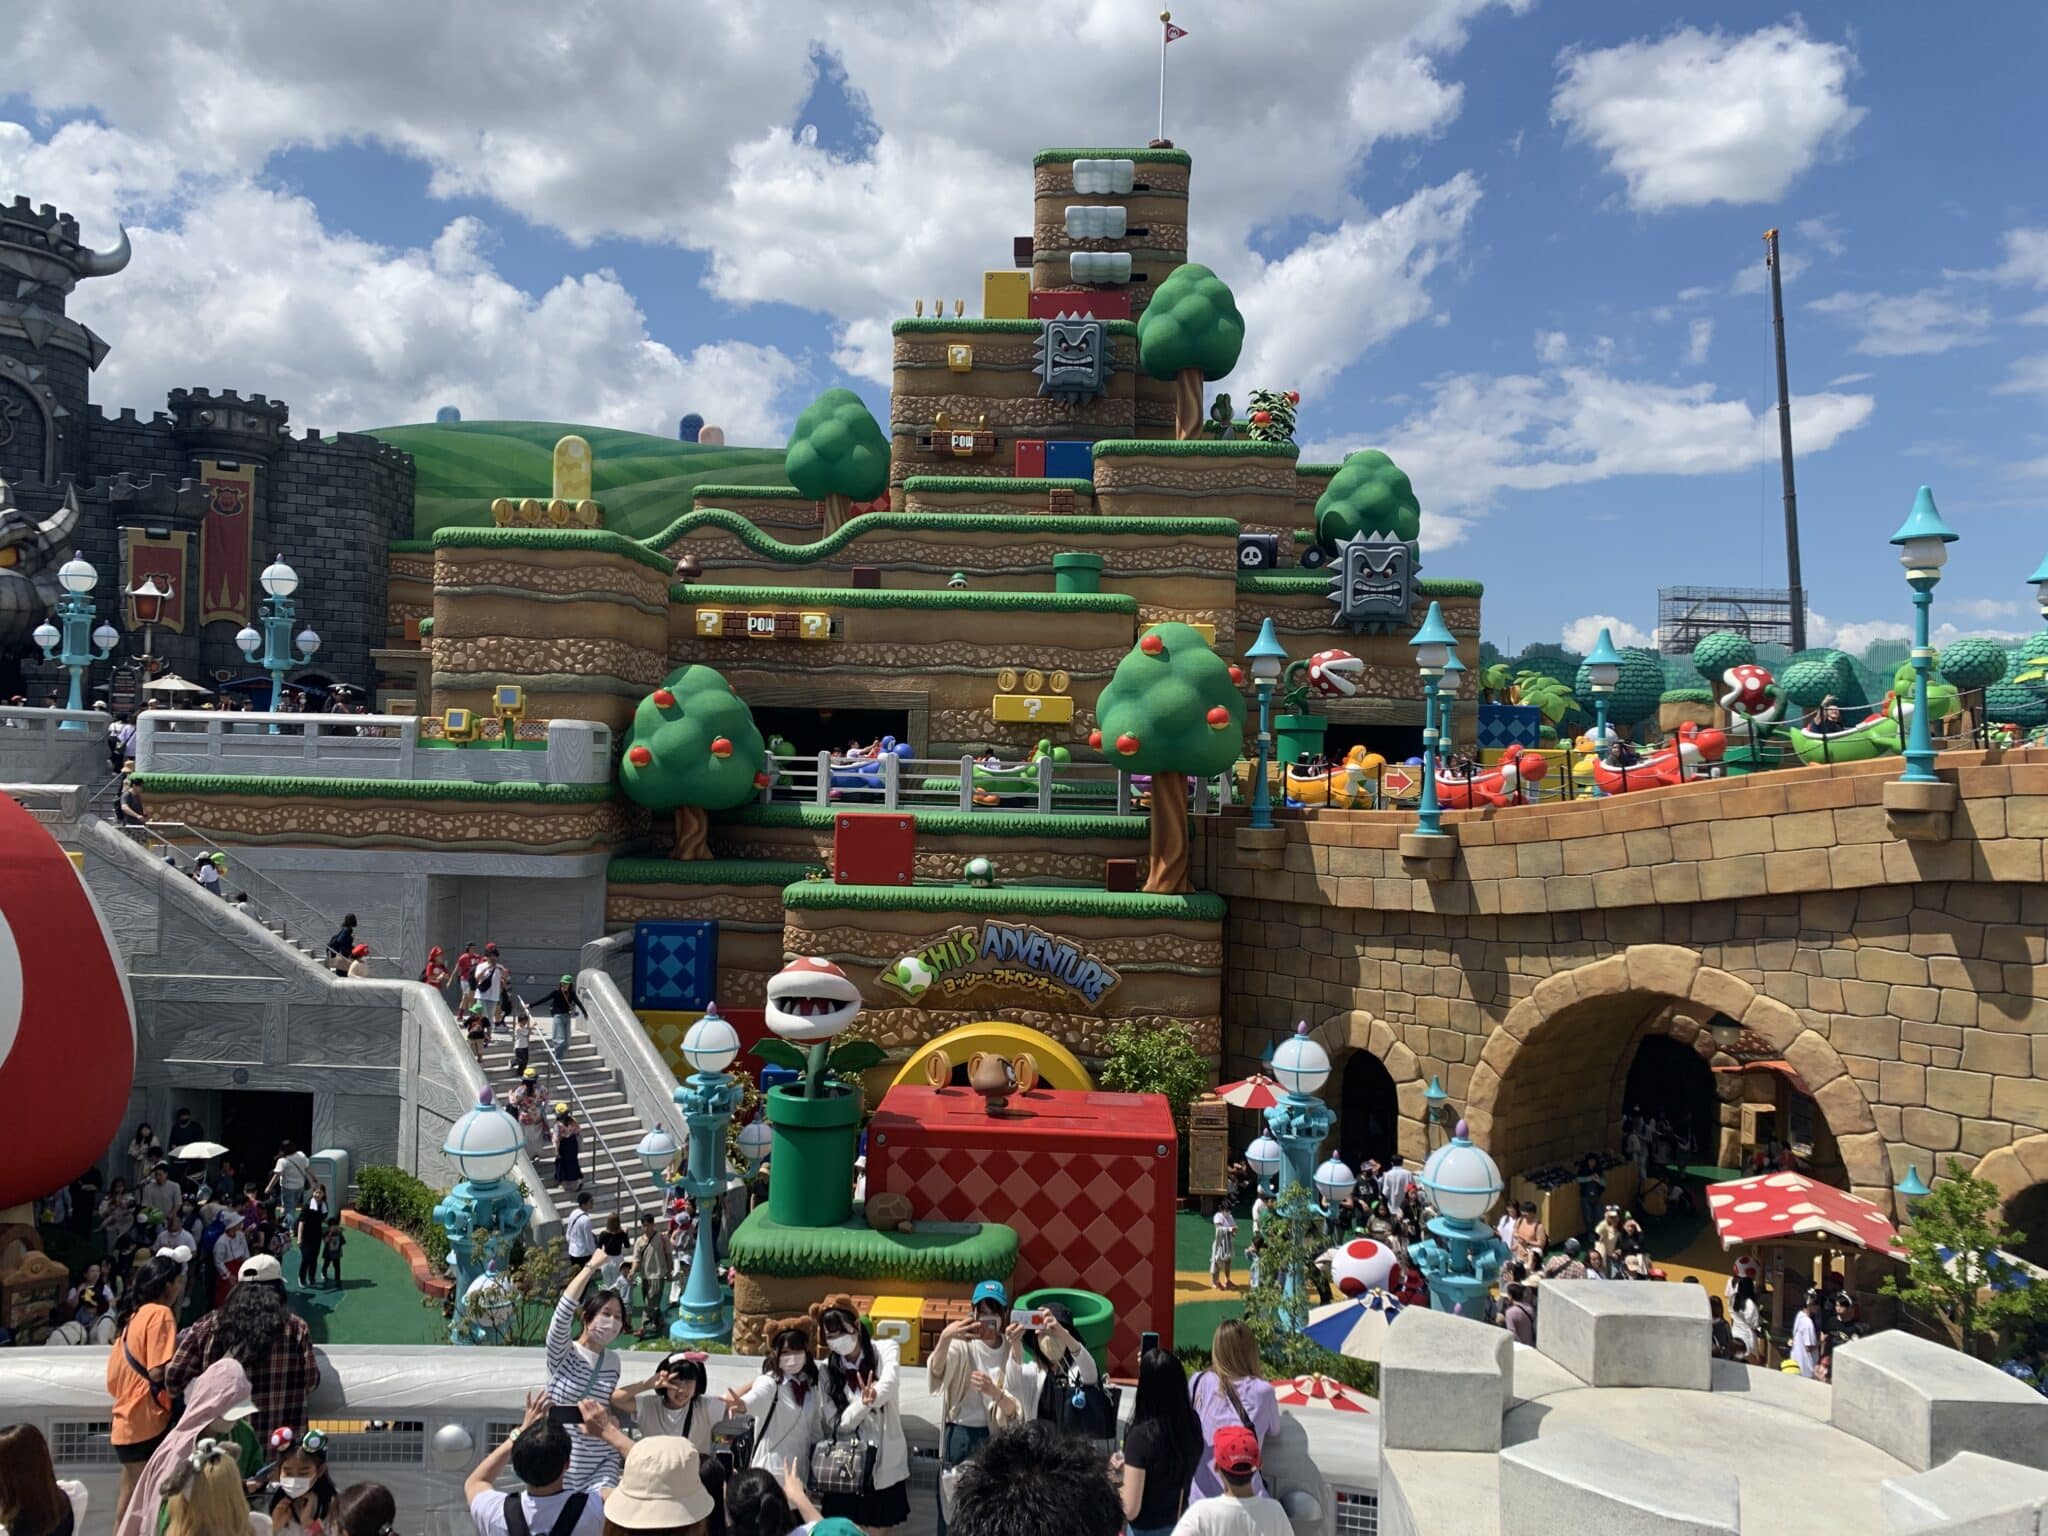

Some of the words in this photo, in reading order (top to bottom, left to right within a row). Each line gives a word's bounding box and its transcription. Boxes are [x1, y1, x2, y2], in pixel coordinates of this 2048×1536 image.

[951, 434, 974, 448] POW
[747, 616, 775, 632] POW
[981, 925, 1116, 1003] ADVENTURE
